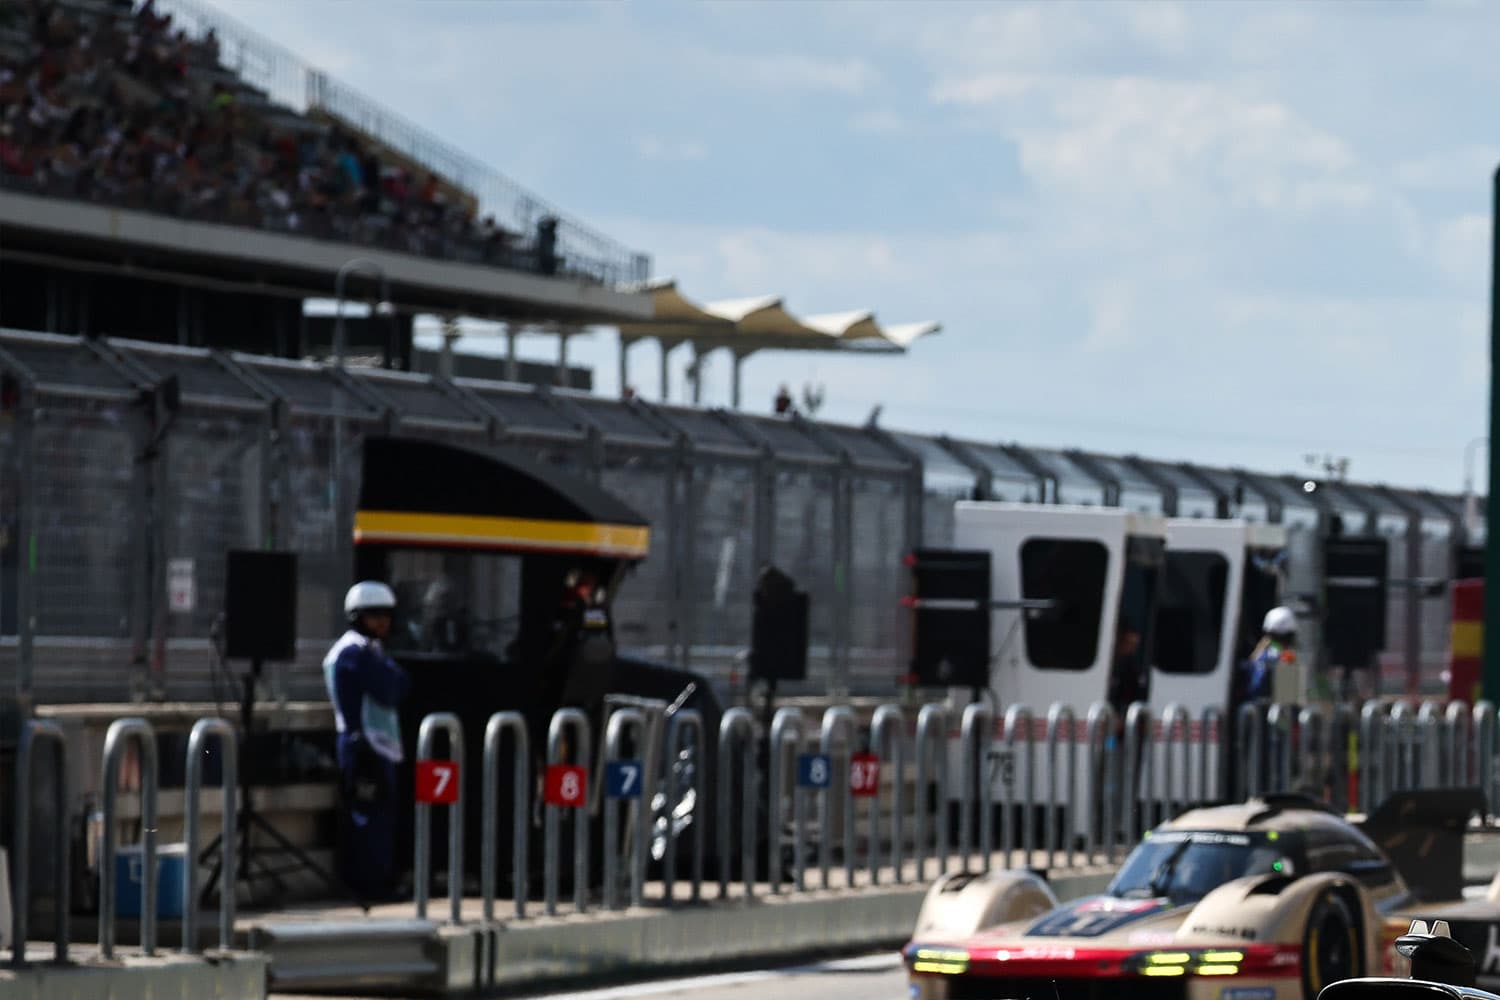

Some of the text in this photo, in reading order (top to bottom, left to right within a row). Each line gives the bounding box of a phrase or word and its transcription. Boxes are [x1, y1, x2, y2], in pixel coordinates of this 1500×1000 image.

[433, 768, 451, 797] 7
[621, 766, 638, 793] 7
[810, 757, 828, 784] 8
[560, 772, 580, 800] 8
